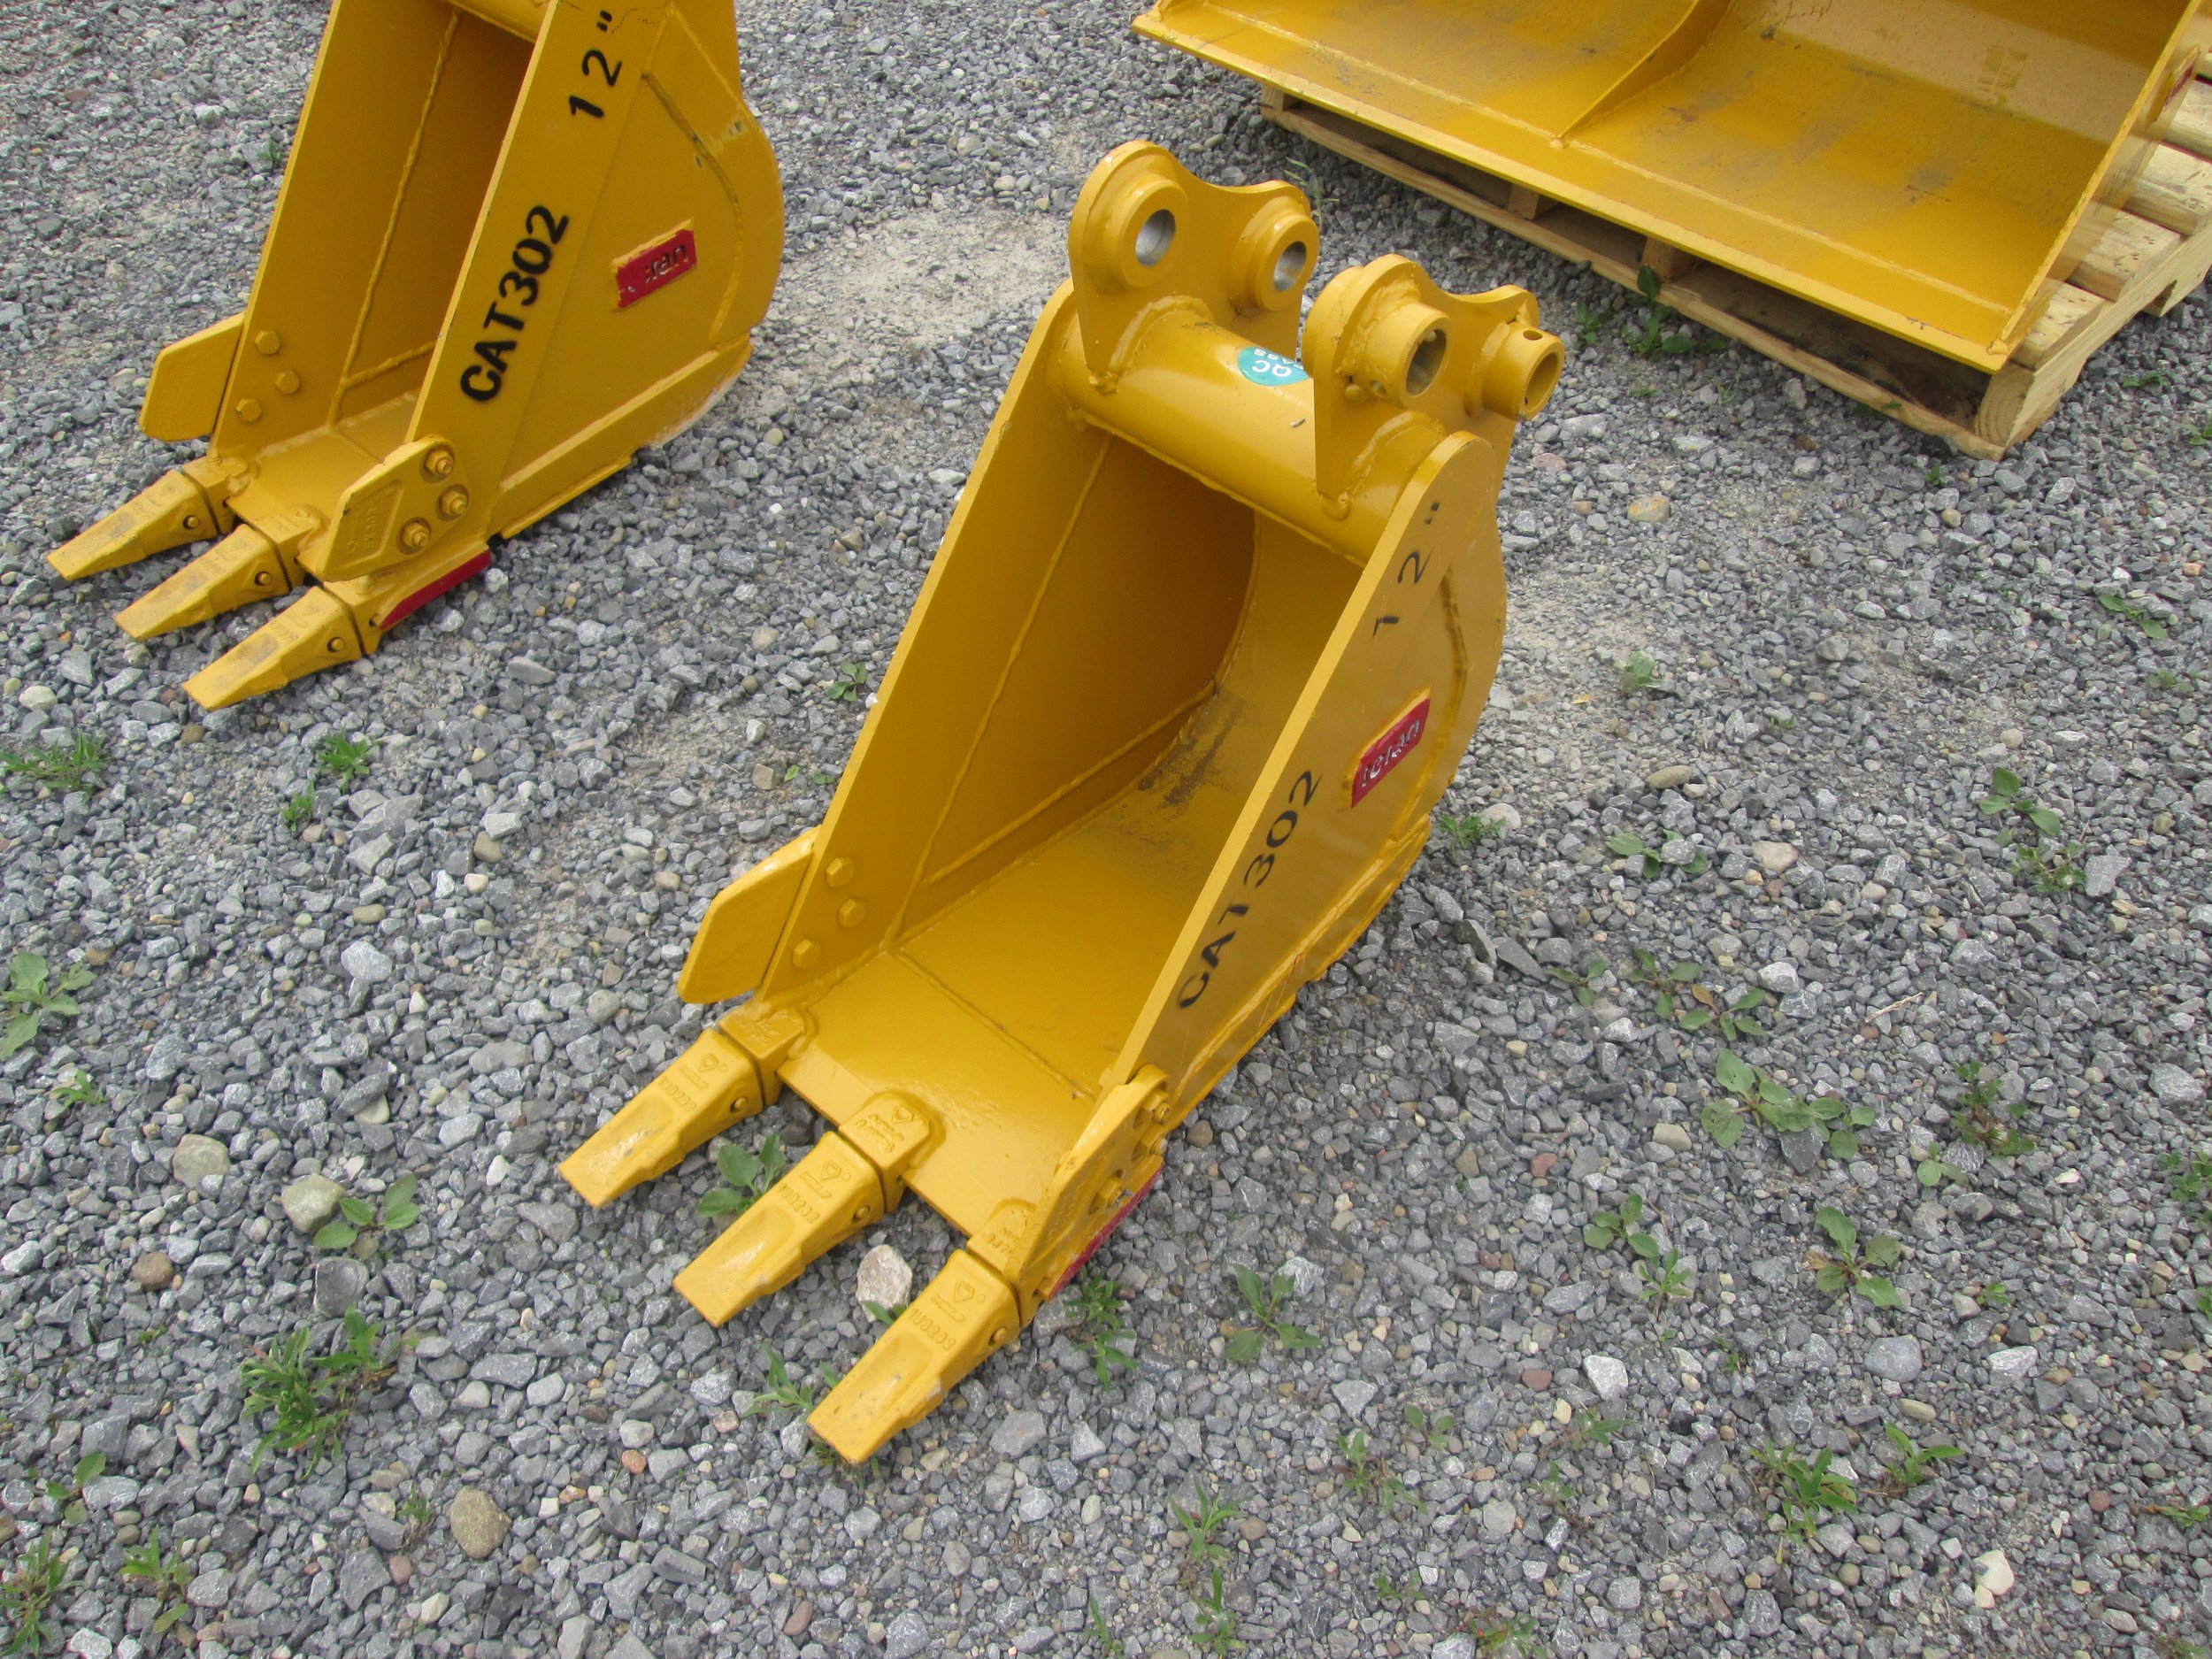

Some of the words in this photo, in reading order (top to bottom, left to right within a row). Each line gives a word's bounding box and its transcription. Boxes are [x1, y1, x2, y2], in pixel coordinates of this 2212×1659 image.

[459, 204, 570, 403] CAT302
[1251, 359, 1292, 377] QC
[1178, 770, 1323, 1009] CAT302
